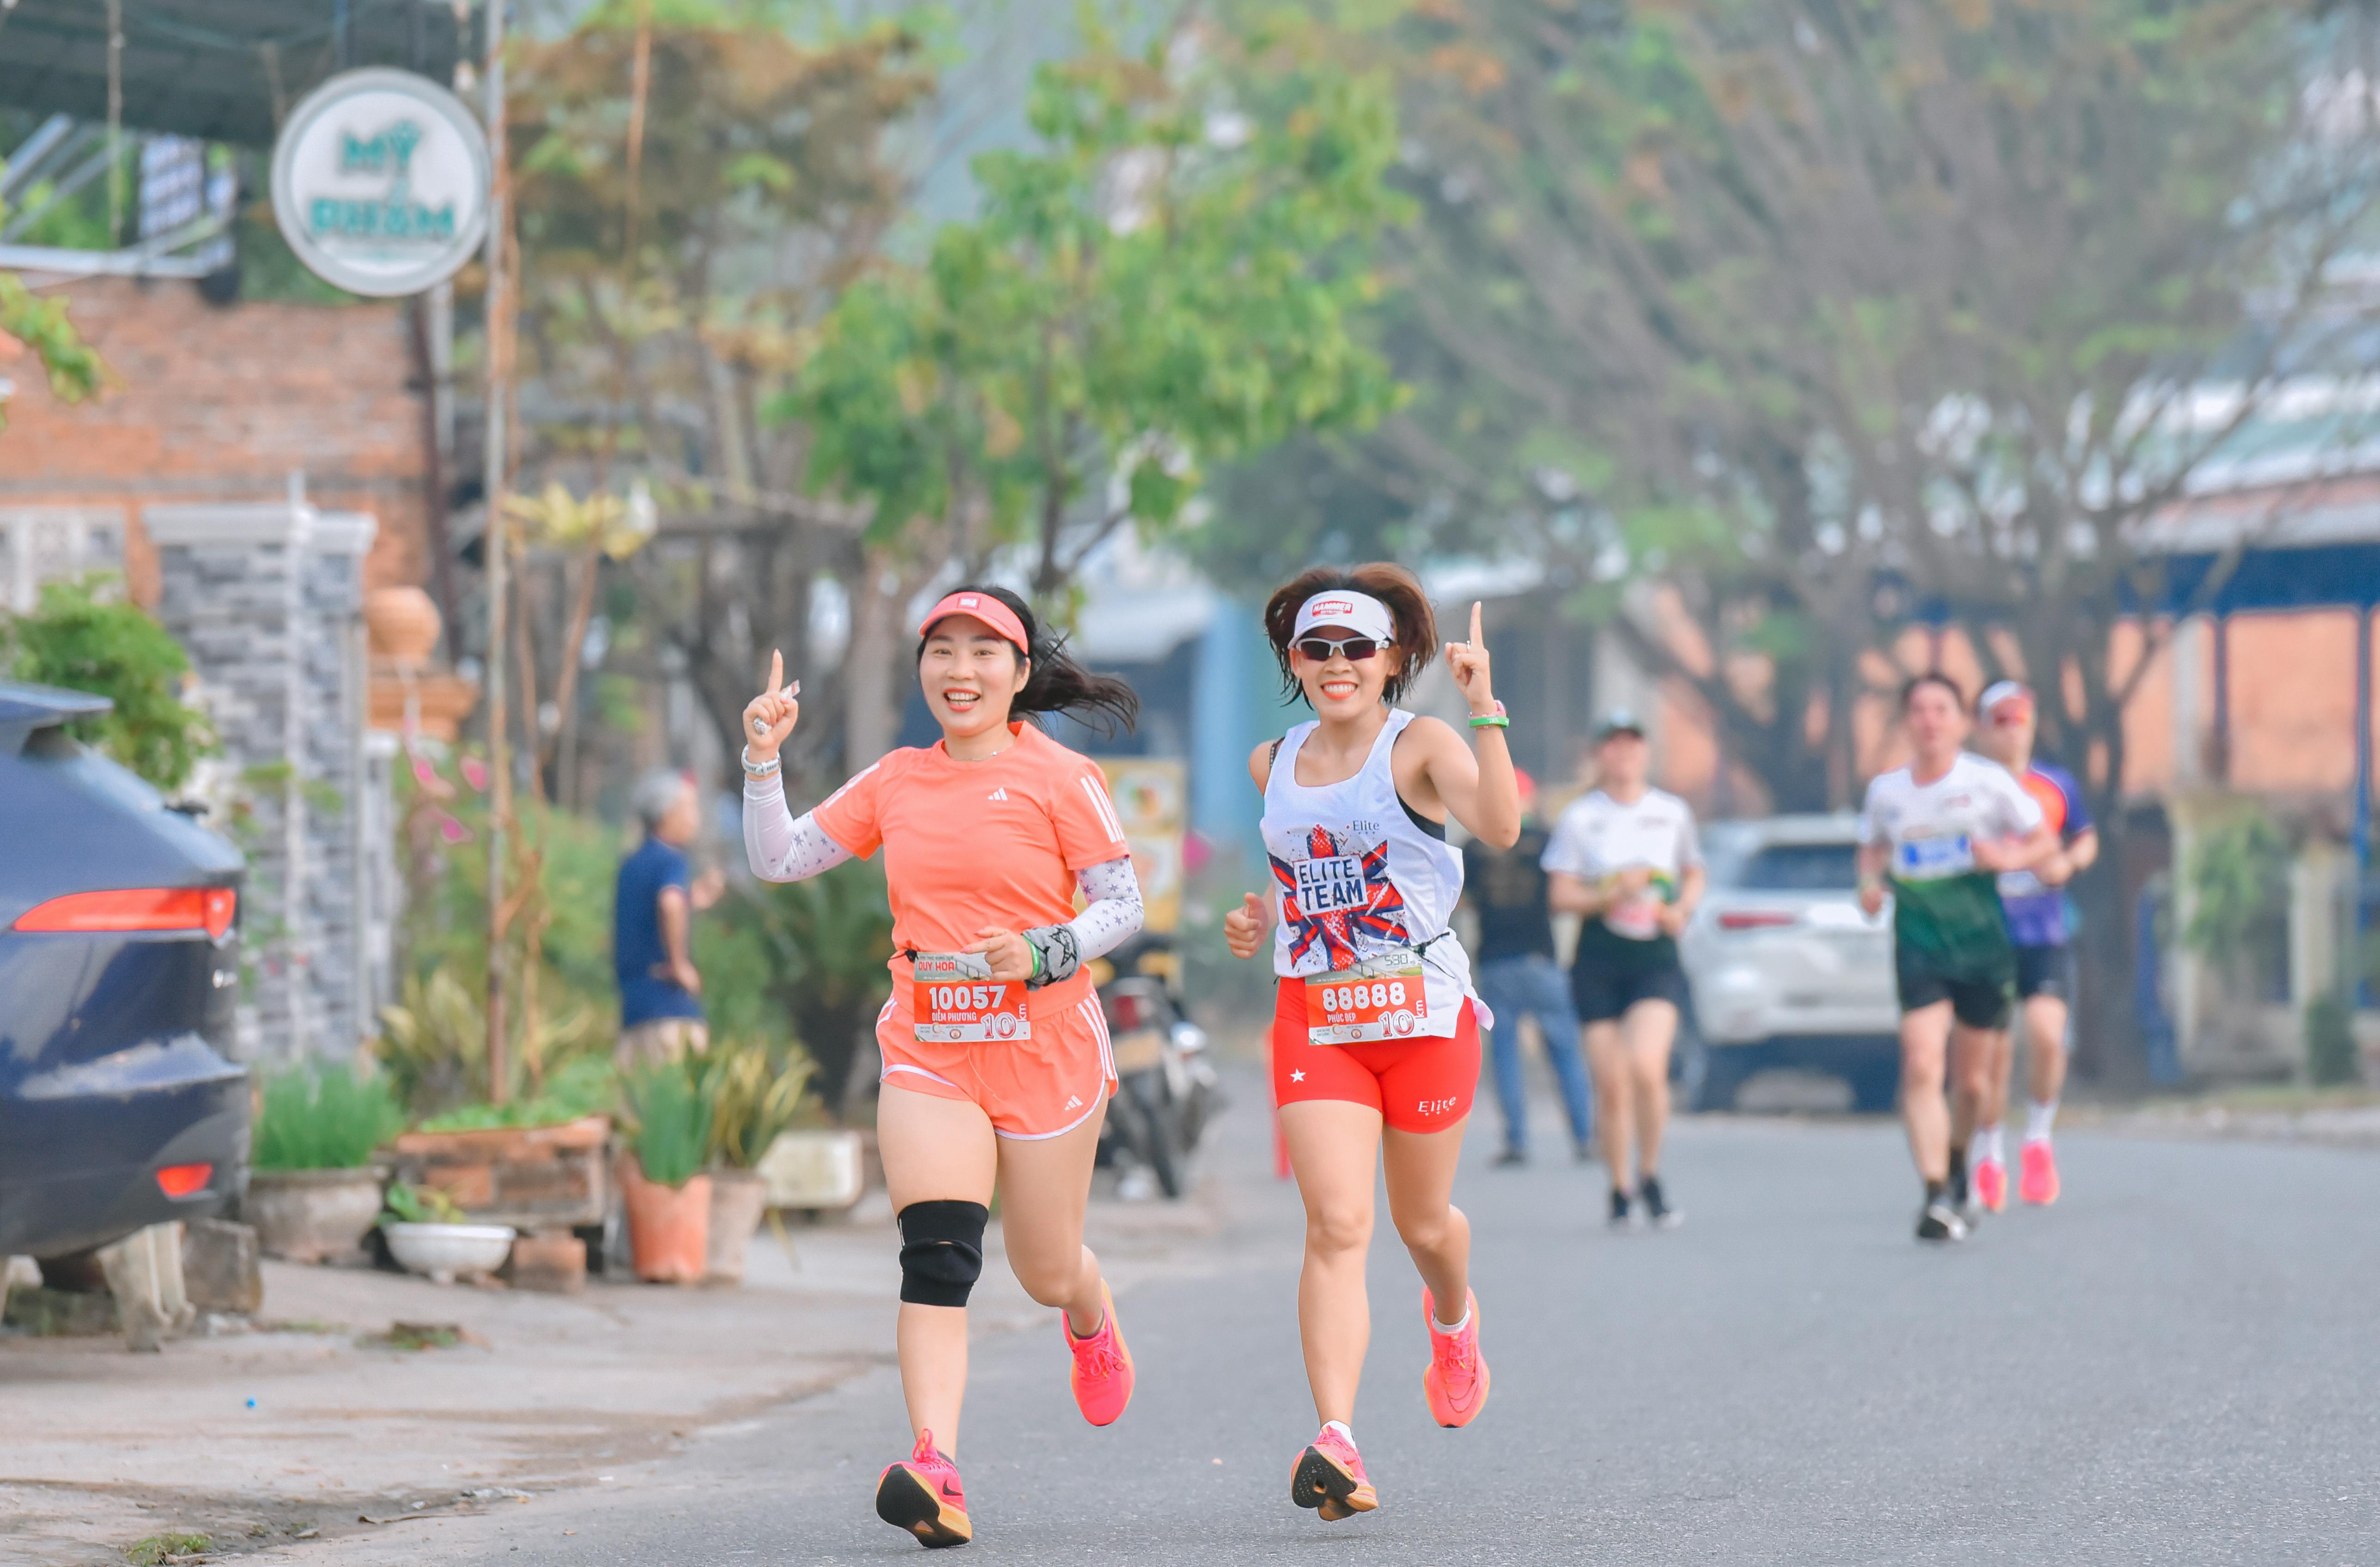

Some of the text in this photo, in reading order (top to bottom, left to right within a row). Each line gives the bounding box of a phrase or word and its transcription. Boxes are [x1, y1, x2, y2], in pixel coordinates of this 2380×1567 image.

[1353, 820, 1379, 831] Elite
[1299, 858, 1355, 884] ELITE
[1301, 879, 1363, 911] TEAM
[929, 985, 1007, 1010] 10057
[1323, 982, 1406, 1011] 88888
[980, 1003, 1026, 1039] 10 km
[1327, 1012, 1344, 1023] PHÚC
[1378, 1000, 1424, 1038] 10 km
[1417, 1097, 1456, 1112] Elite
